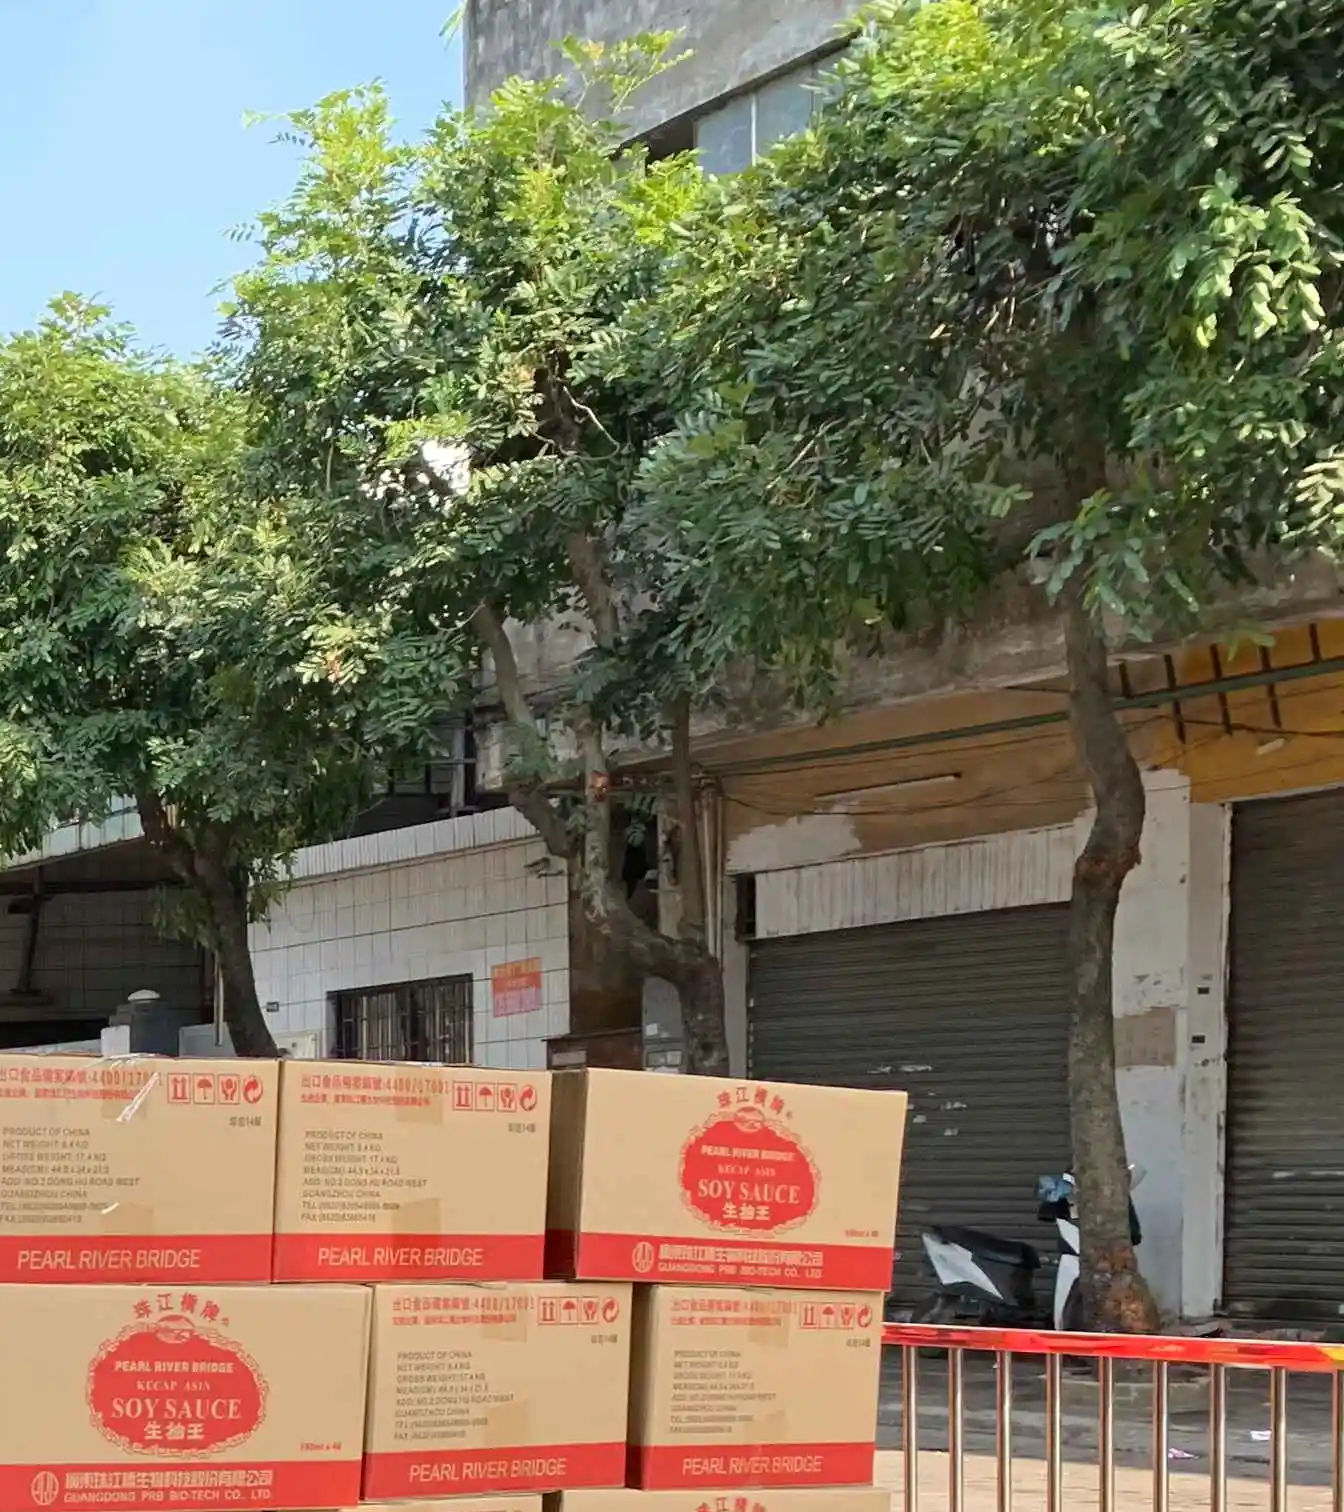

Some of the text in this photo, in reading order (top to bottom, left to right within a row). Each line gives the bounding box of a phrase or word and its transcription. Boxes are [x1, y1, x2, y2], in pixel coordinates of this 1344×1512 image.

[701, 1145, 794, 1163] PEARL RIVER BRIDGE
[697, 1178, 800, 1204] SOY SAUCE
[17, 1249, 200, 1270] PEARL RIVER BRIDGE
[318, 1247, 482, 1267] PEARL RIVER BRIDGE
[114, 1360, 234, 1374] PEARL RIVER BRIDGE
[111, 1397, 242, 1420] SOY SAUCE
[409, 1458, 566, 1483] PEARL RIVER BRIDGE
[682, 1456, 821, 1475] PEARL RIVER BRIDGE
[63, 1491, 135, 1503] GUANGDONG
